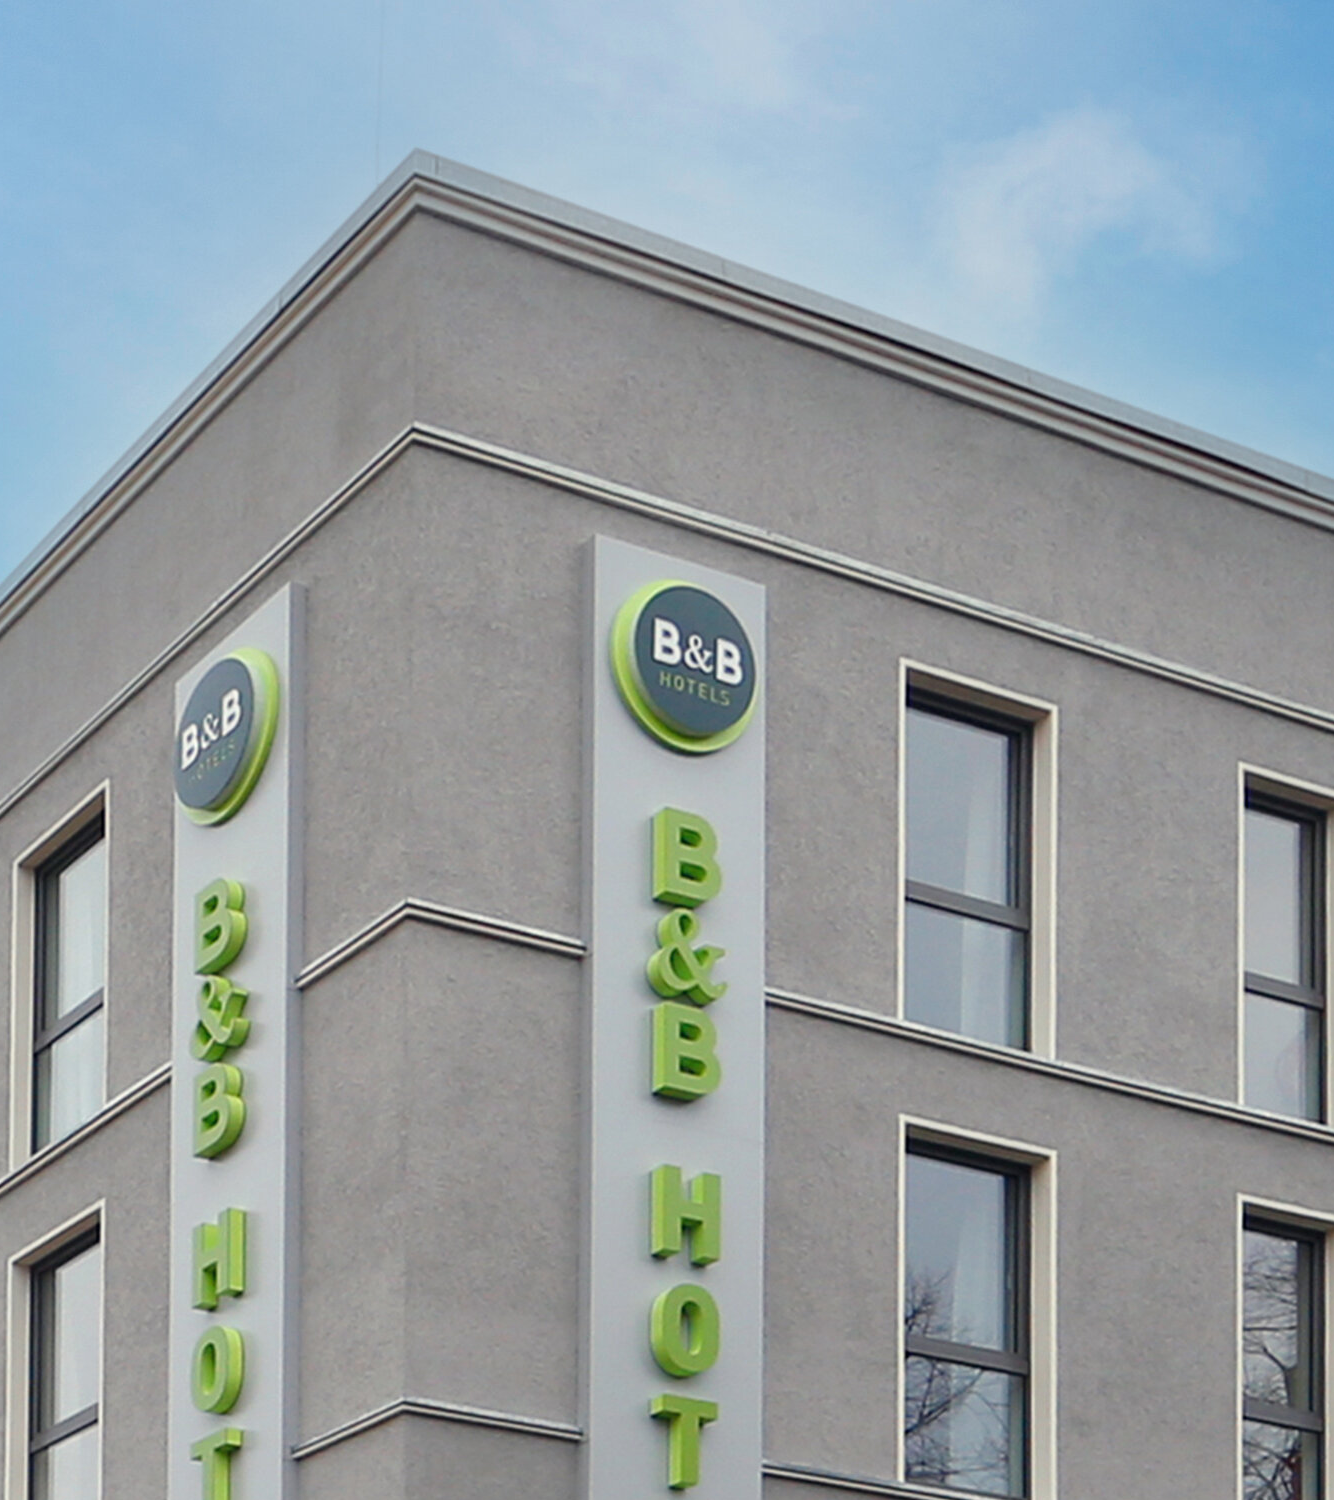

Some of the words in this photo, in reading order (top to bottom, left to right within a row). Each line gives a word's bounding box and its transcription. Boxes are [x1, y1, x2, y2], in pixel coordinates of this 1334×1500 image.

[654, 617, 743, 686] B&B
[659, 671, 731, 707] HOTELS
[181, 688, 241, 771] B&B
[646, 805, 728, 1101] B&B
[189, 877, 250, 1160] B&B
